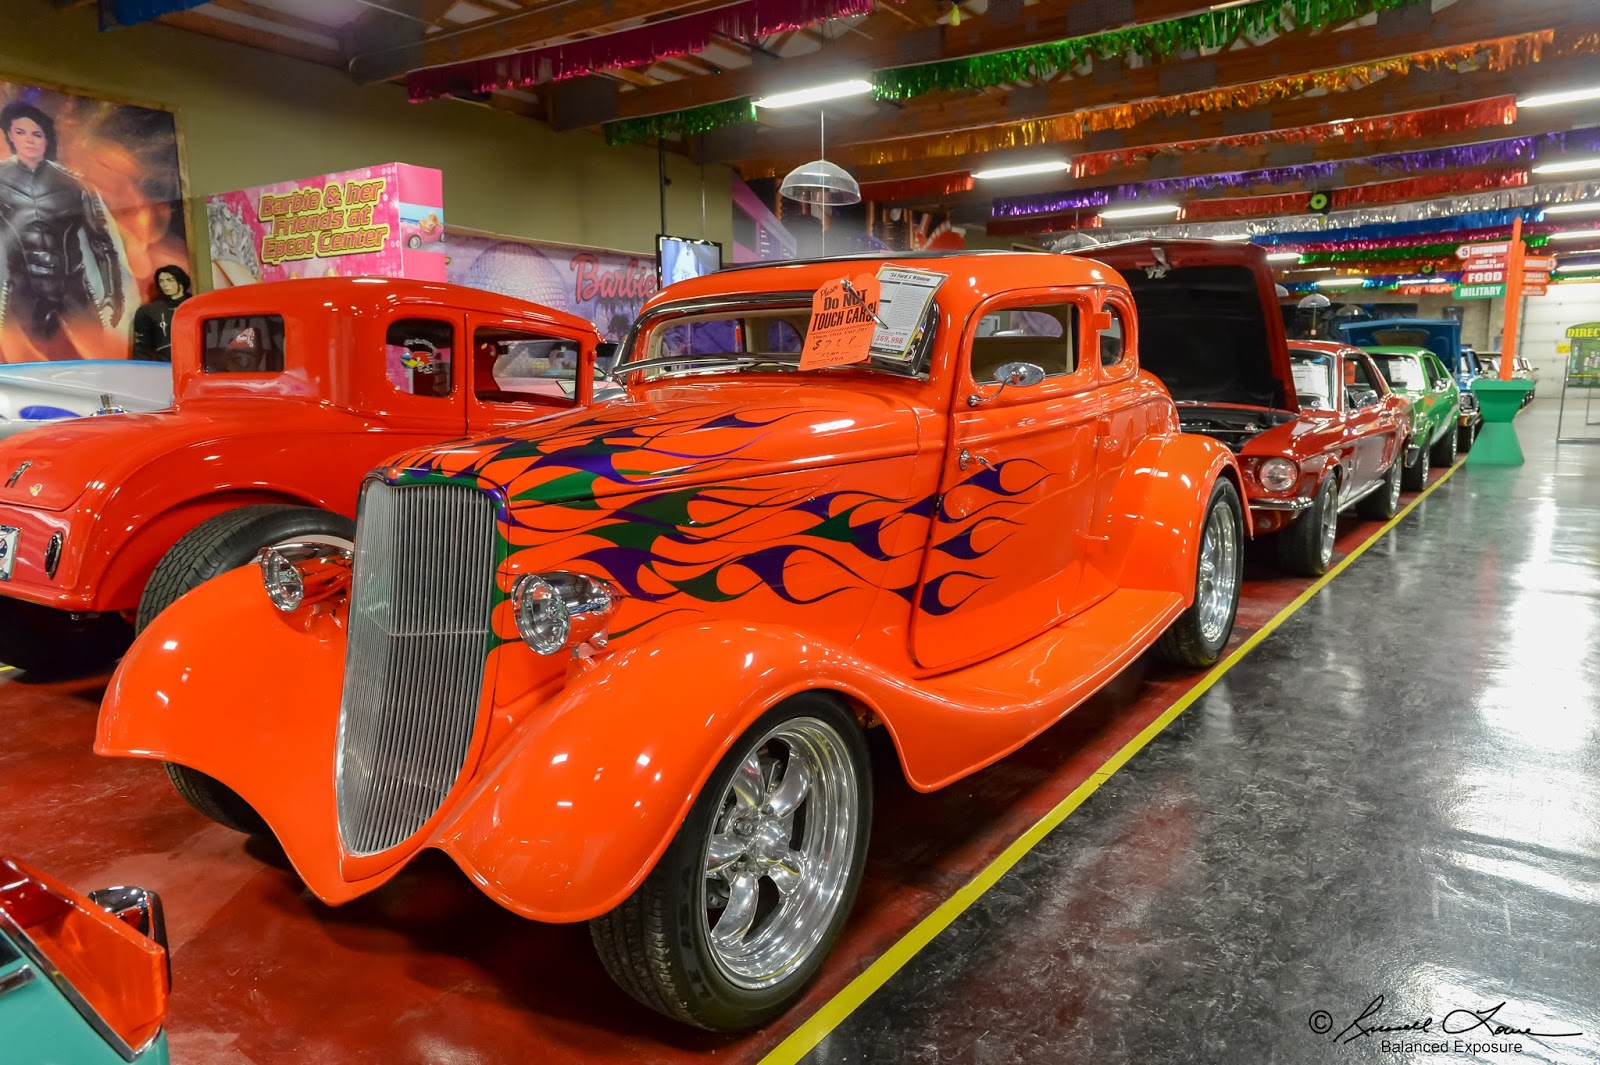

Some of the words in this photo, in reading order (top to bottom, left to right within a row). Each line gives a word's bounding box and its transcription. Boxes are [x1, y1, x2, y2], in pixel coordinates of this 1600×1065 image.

[260, 191, 320, 217] Barbie
[324, 184, 342, 208] &
[346, 180, 384, 203] her
[273, 208, 344, 237] Friends
[348, 204, 371, 227] at
[263, 236, 315, 261] Epcot
[318, 226, 387, 252] Center
[1462, 247, 1469, 257] 5
[570, 253, 657, 304] Barbie
[1467, 271, 1503, 283] FOOD
[823, 296, 840, 312] Do
[842, 288, 868, 308] NOT
[1460, 285, 1502, 298] MILITARY
[812, 310, 845, 332] TOUCH
[845, 301, 877, 325] CARS!
[875, 334, 904, 345] $69,998
[1566, 327, 1600, 338] DIREC
